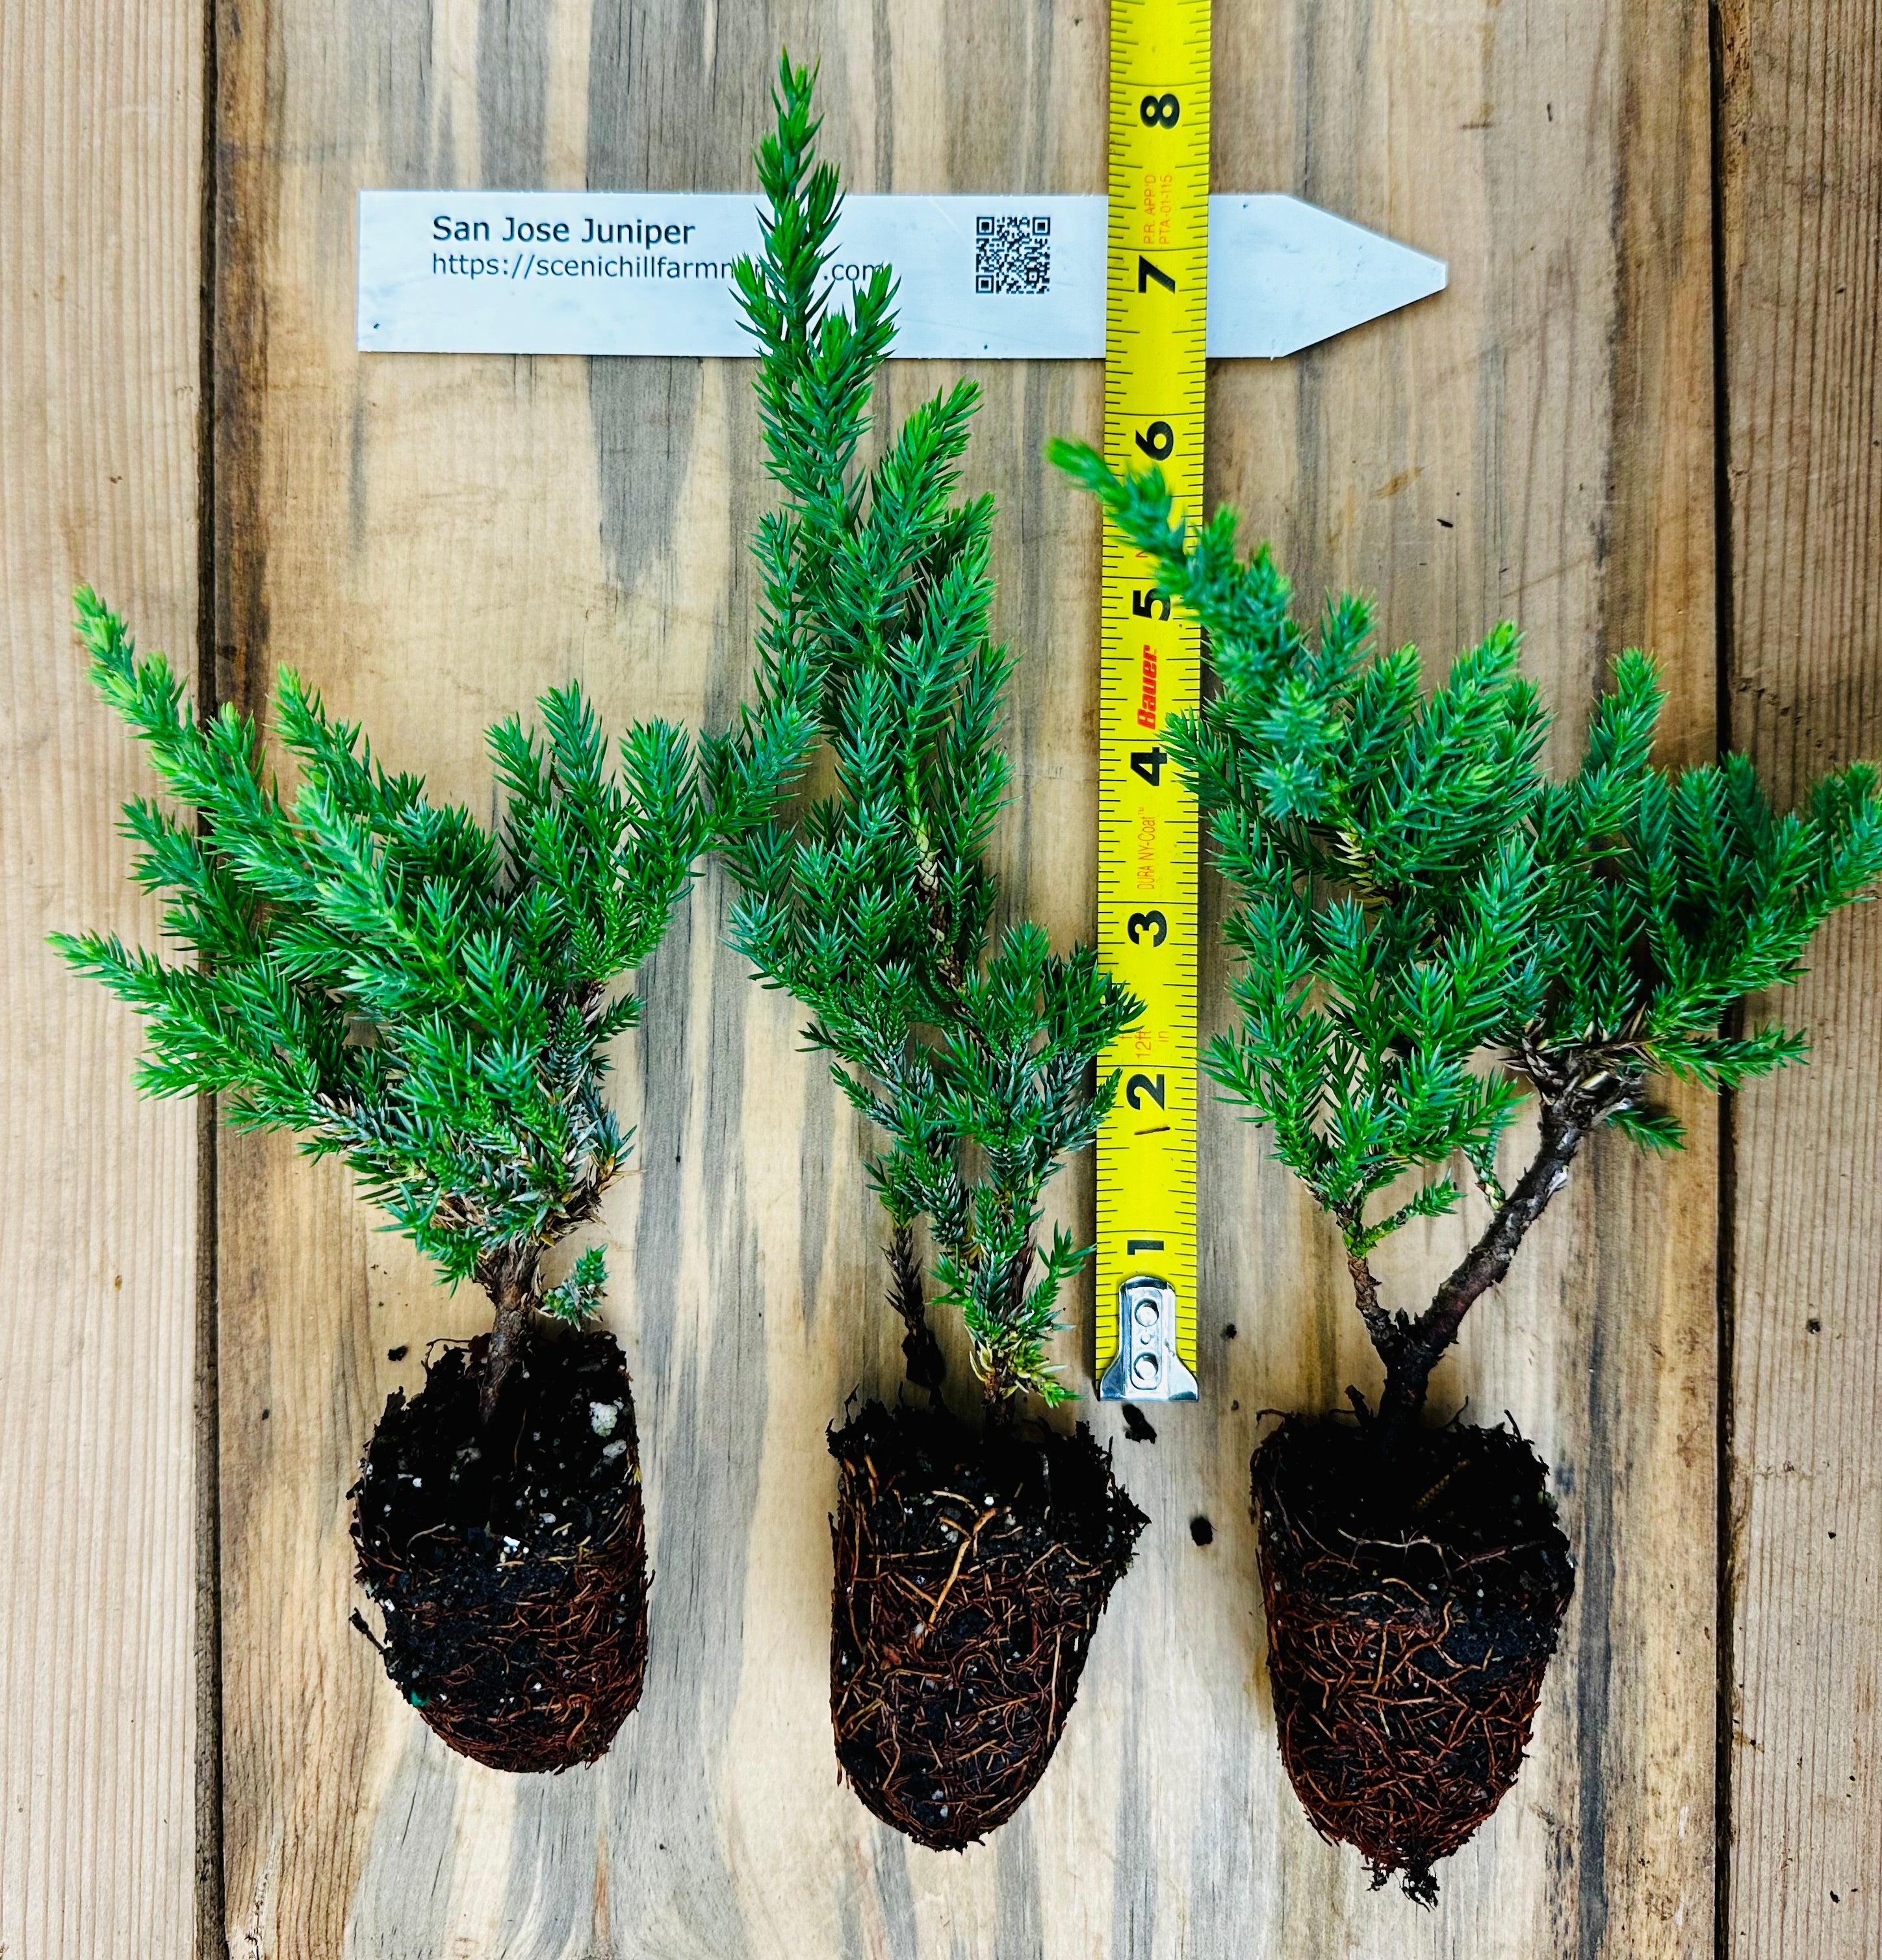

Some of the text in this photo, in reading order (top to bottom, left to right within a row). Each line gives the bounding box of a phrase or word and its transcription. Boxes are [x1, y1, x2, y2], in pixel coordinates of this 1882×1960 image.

[1140, 94, 1179, 129] 8
[433, 216, 695, 250] San Jose Juniper
[1138, 255, 1175, 293] 7
[1135, 421, 1174, 461] 6
[1133, 588, 1170, 621] 5
[1131, 747, 1168, 786] 4
[1137, 865, 1155, 890] DURA
[1128, 910, 1167, 948] 3
[1135, 1030, 1152, 1059] 12ft
[1158, 1031, 1169, 1042] in
[1126, 1074, 1165, 1111] 2
[1128, 1240, 1165, 1256] 1
